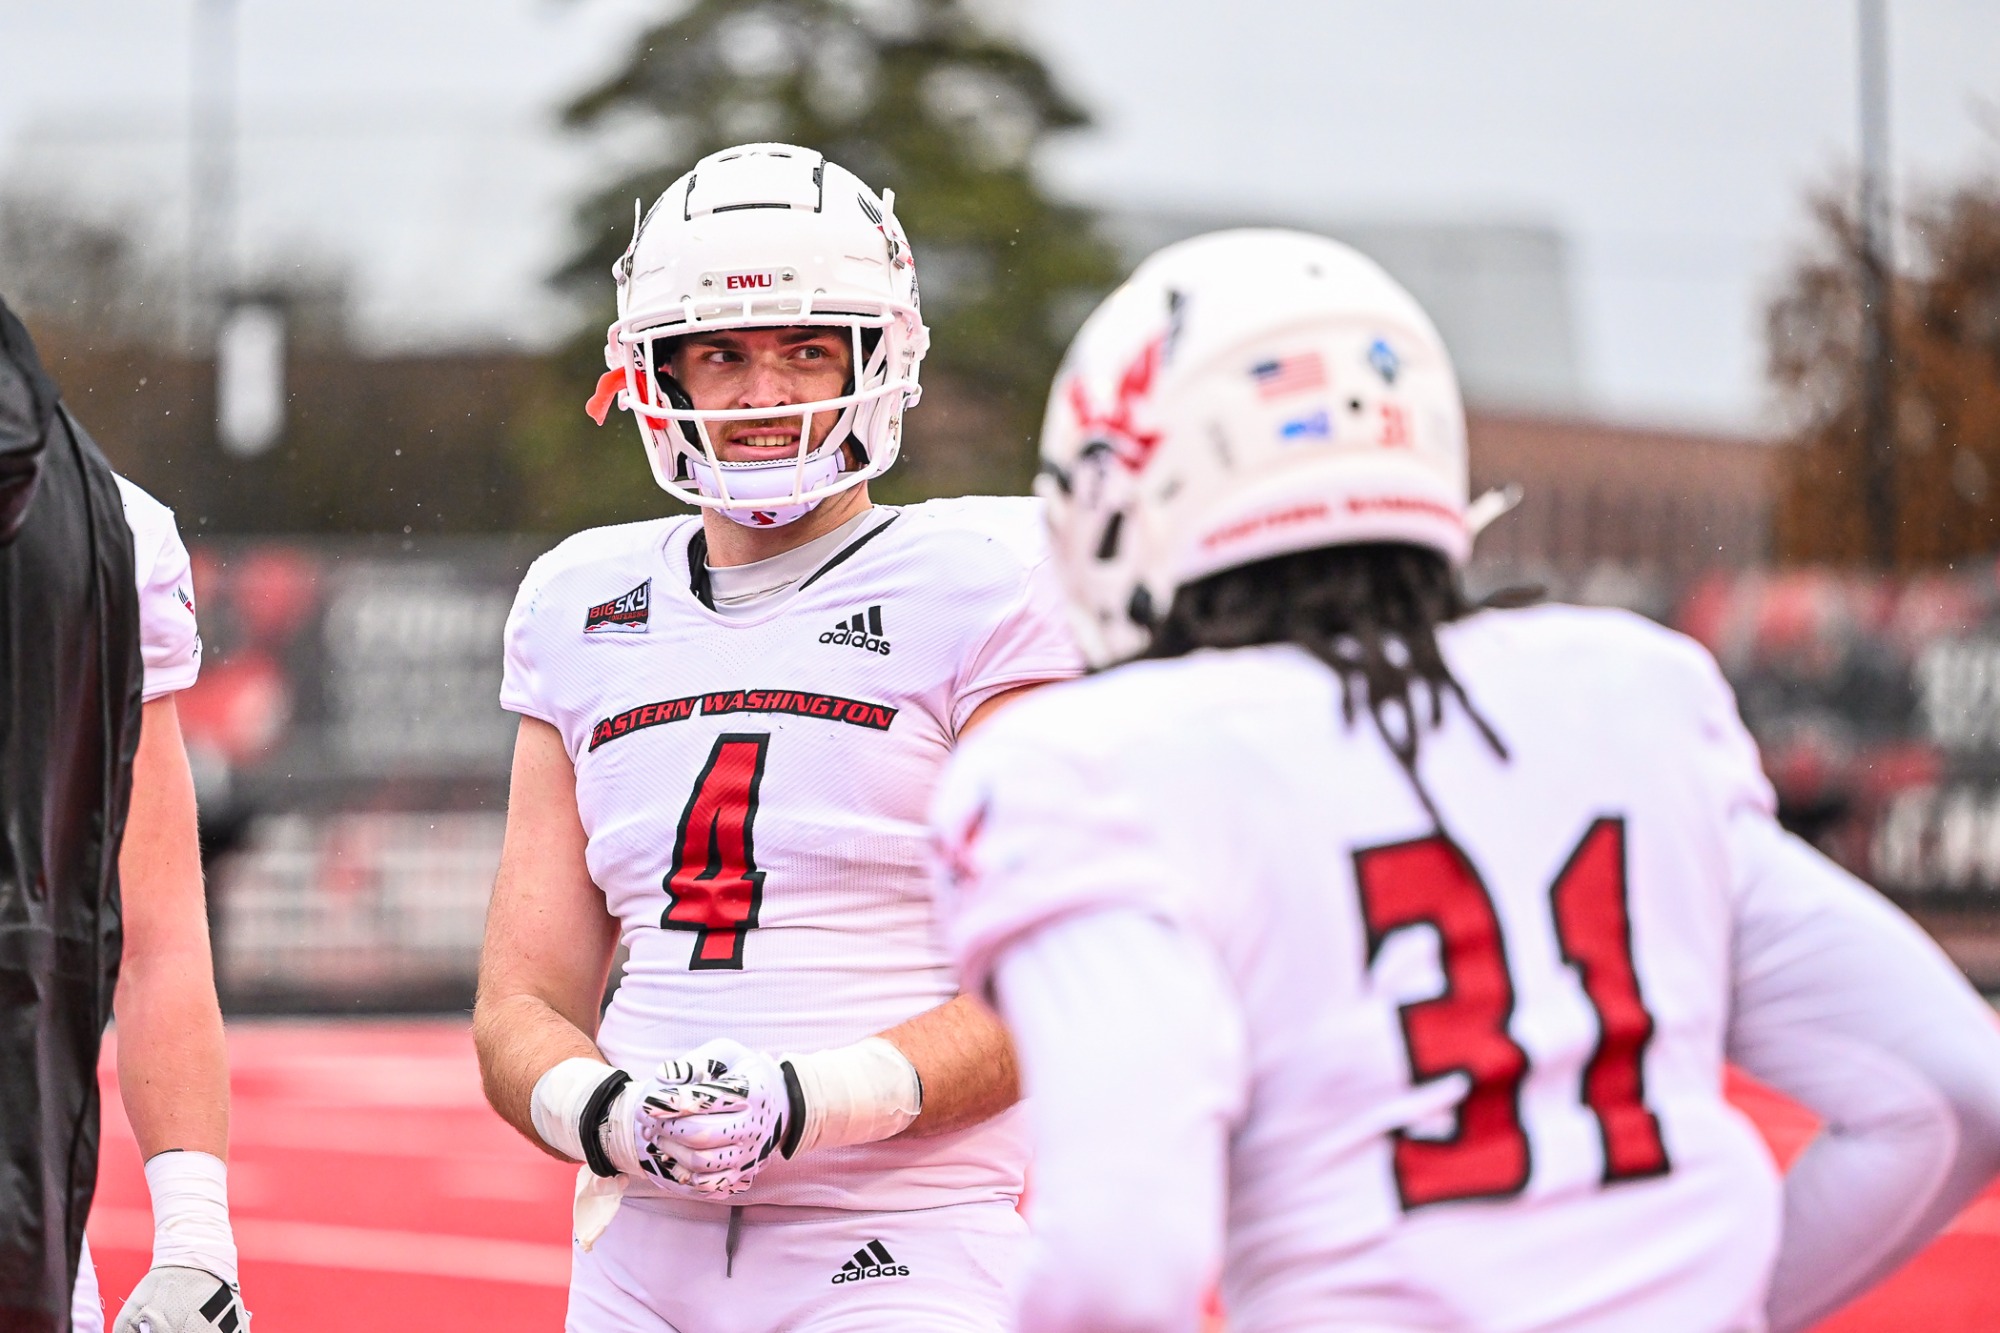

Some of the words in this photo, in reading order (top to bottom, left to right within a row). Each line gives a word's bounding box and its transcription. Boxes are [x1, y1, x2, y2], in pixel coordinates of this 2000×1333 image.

[727, 273, 772, 290] EWU
[819, 629, 891, 656] adidas
[589, 696, 697, 752] EASTERN
[700, 689, 898, 731] WASHINGTON
[660, 733, 771, 970] 4
[1352, 815, 1672, 1212] 31
[831, 1264, 910, 1284] adidas
